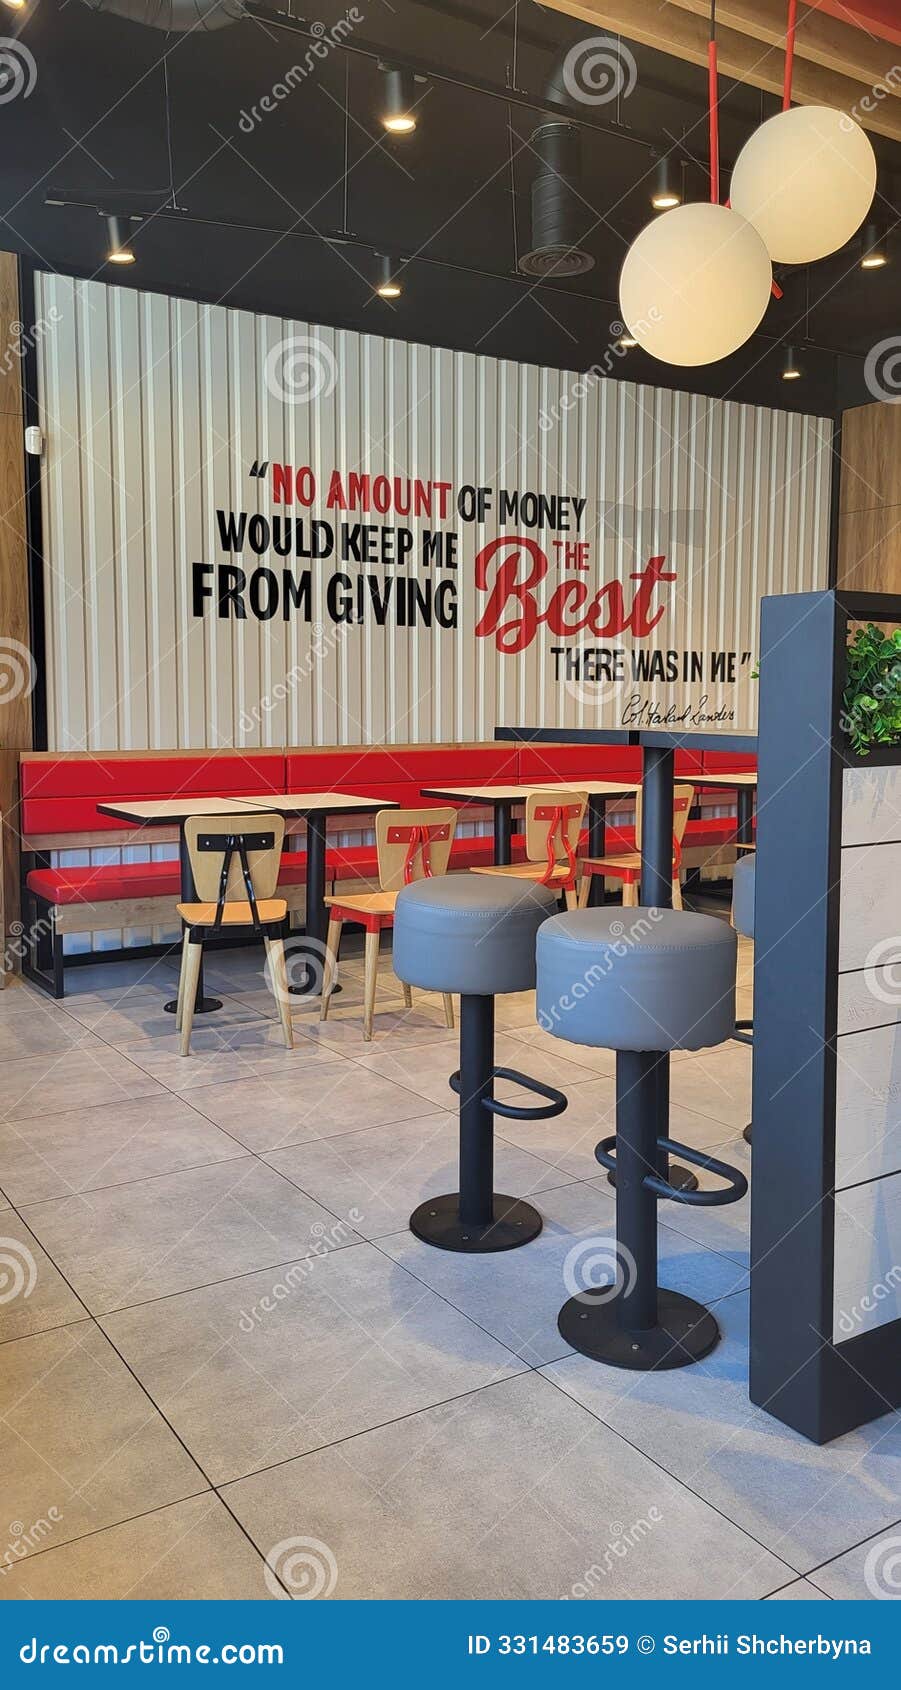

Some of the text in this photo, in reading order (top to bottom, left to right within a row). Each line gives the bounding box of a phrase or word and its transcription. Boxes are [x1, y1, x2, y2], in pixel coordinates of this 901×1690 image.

[326, 470, 452, 519] AMOUNT
[457, 485, 493, 523] OF
[499, 490, 587, 532] MONEY
[216, 509, 590, 571] WOULD KEEP ME THE
[192, 535, 678, 655] FROM GIVING Best
[550, 647, 624, 681] THERE
[631, 650, 679, 682] WAS
[683, 651, 703, 682] IN
